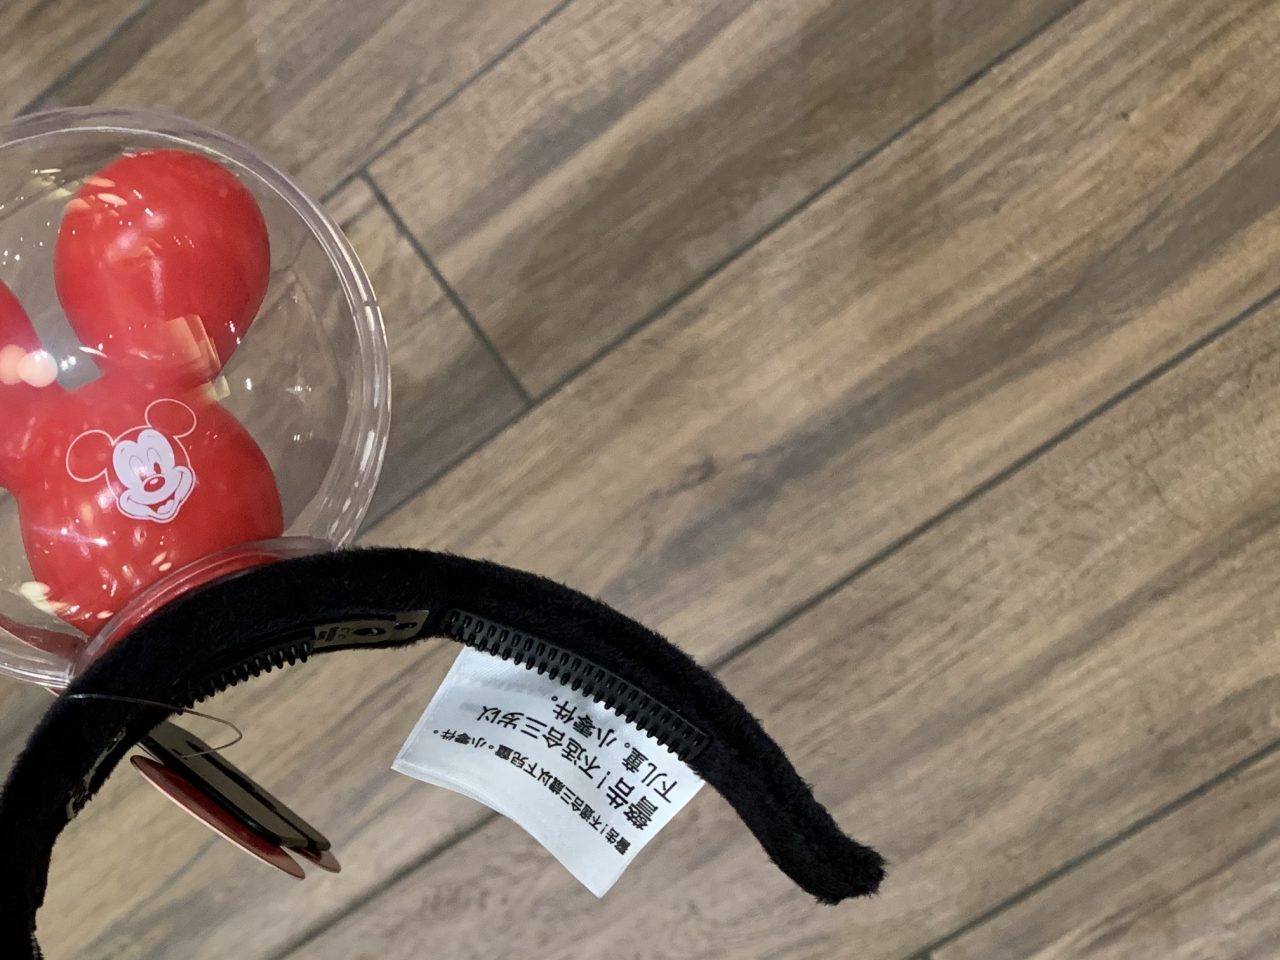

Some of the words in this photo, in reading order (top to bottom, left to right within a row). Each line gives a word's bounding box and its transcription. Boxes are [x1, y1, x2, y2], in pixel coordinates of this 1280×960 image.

[551, 696, 678, 803] 下儿童。小零件。
